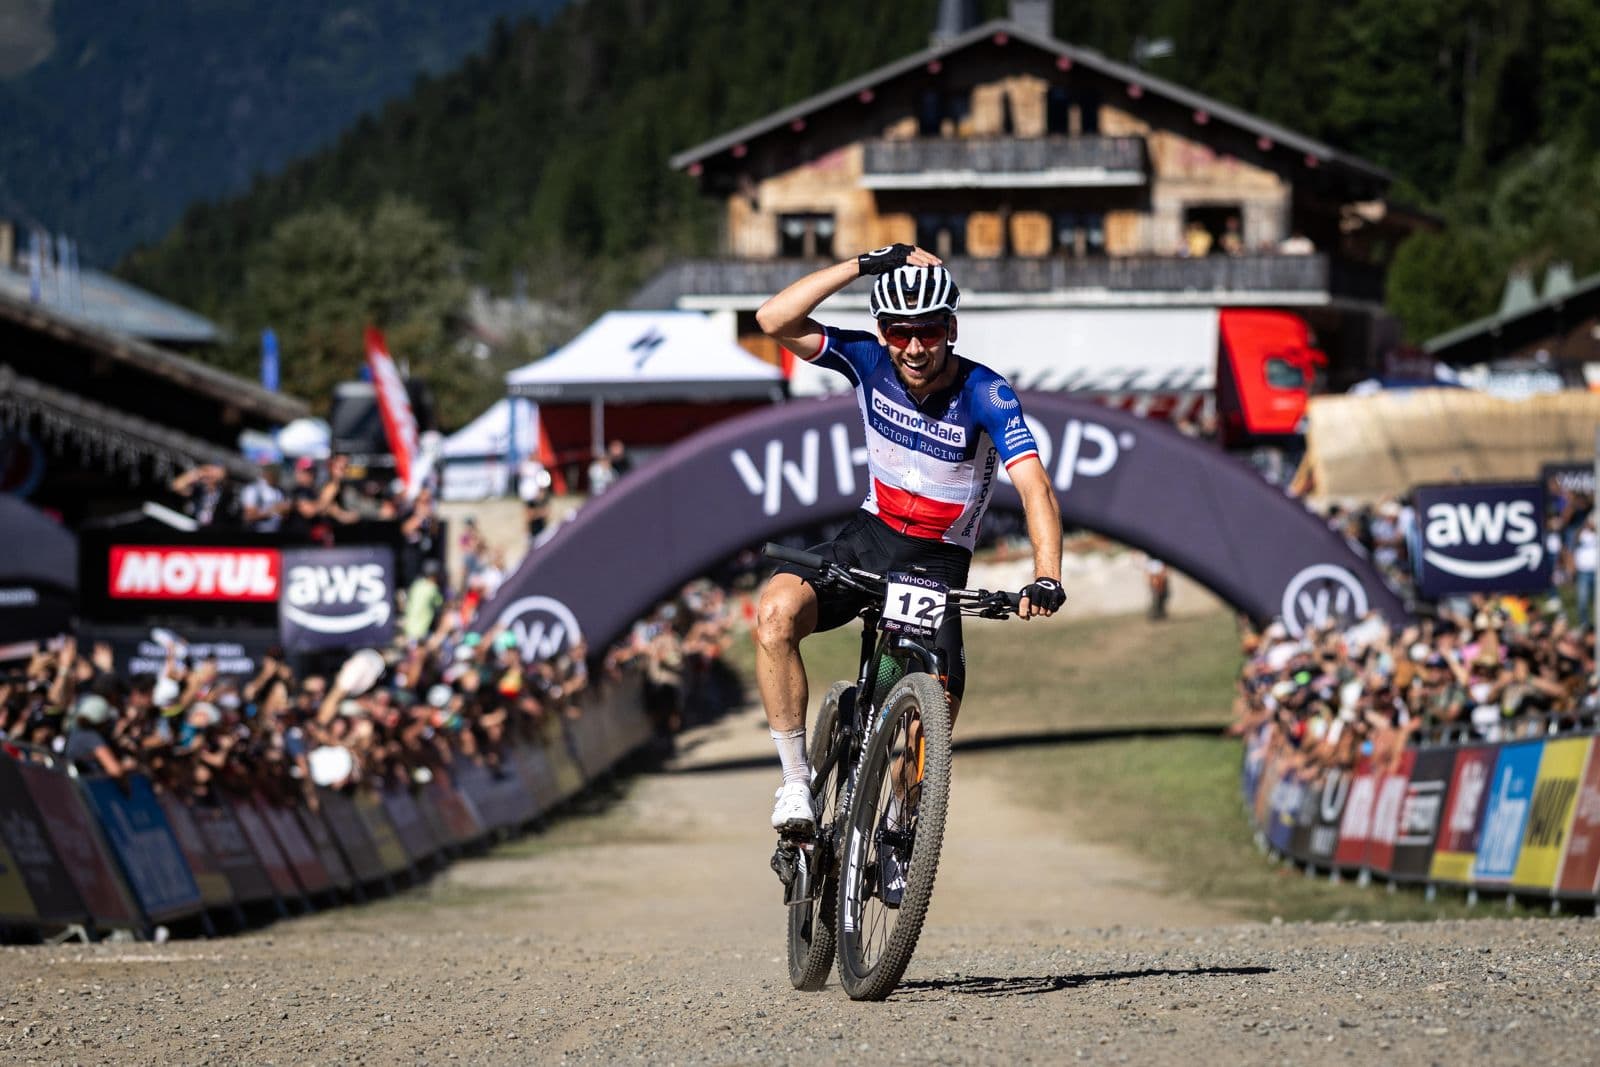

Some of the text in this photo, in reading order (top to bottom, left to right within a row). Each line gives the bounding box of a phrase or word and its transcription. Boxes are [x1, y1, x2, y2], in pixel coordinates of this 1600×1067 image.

[873, 417, 964, 461] FACTORY RACING
[874, 398, 961, 443] cannondale
[1426, 500, 1538, 548] aws
[117, 551, 276, 596] MOTUL
[287, 563, 386, 606] aws
[899, 575, 938, 588] WHOOP
[899, 592, 936, 621] 12
